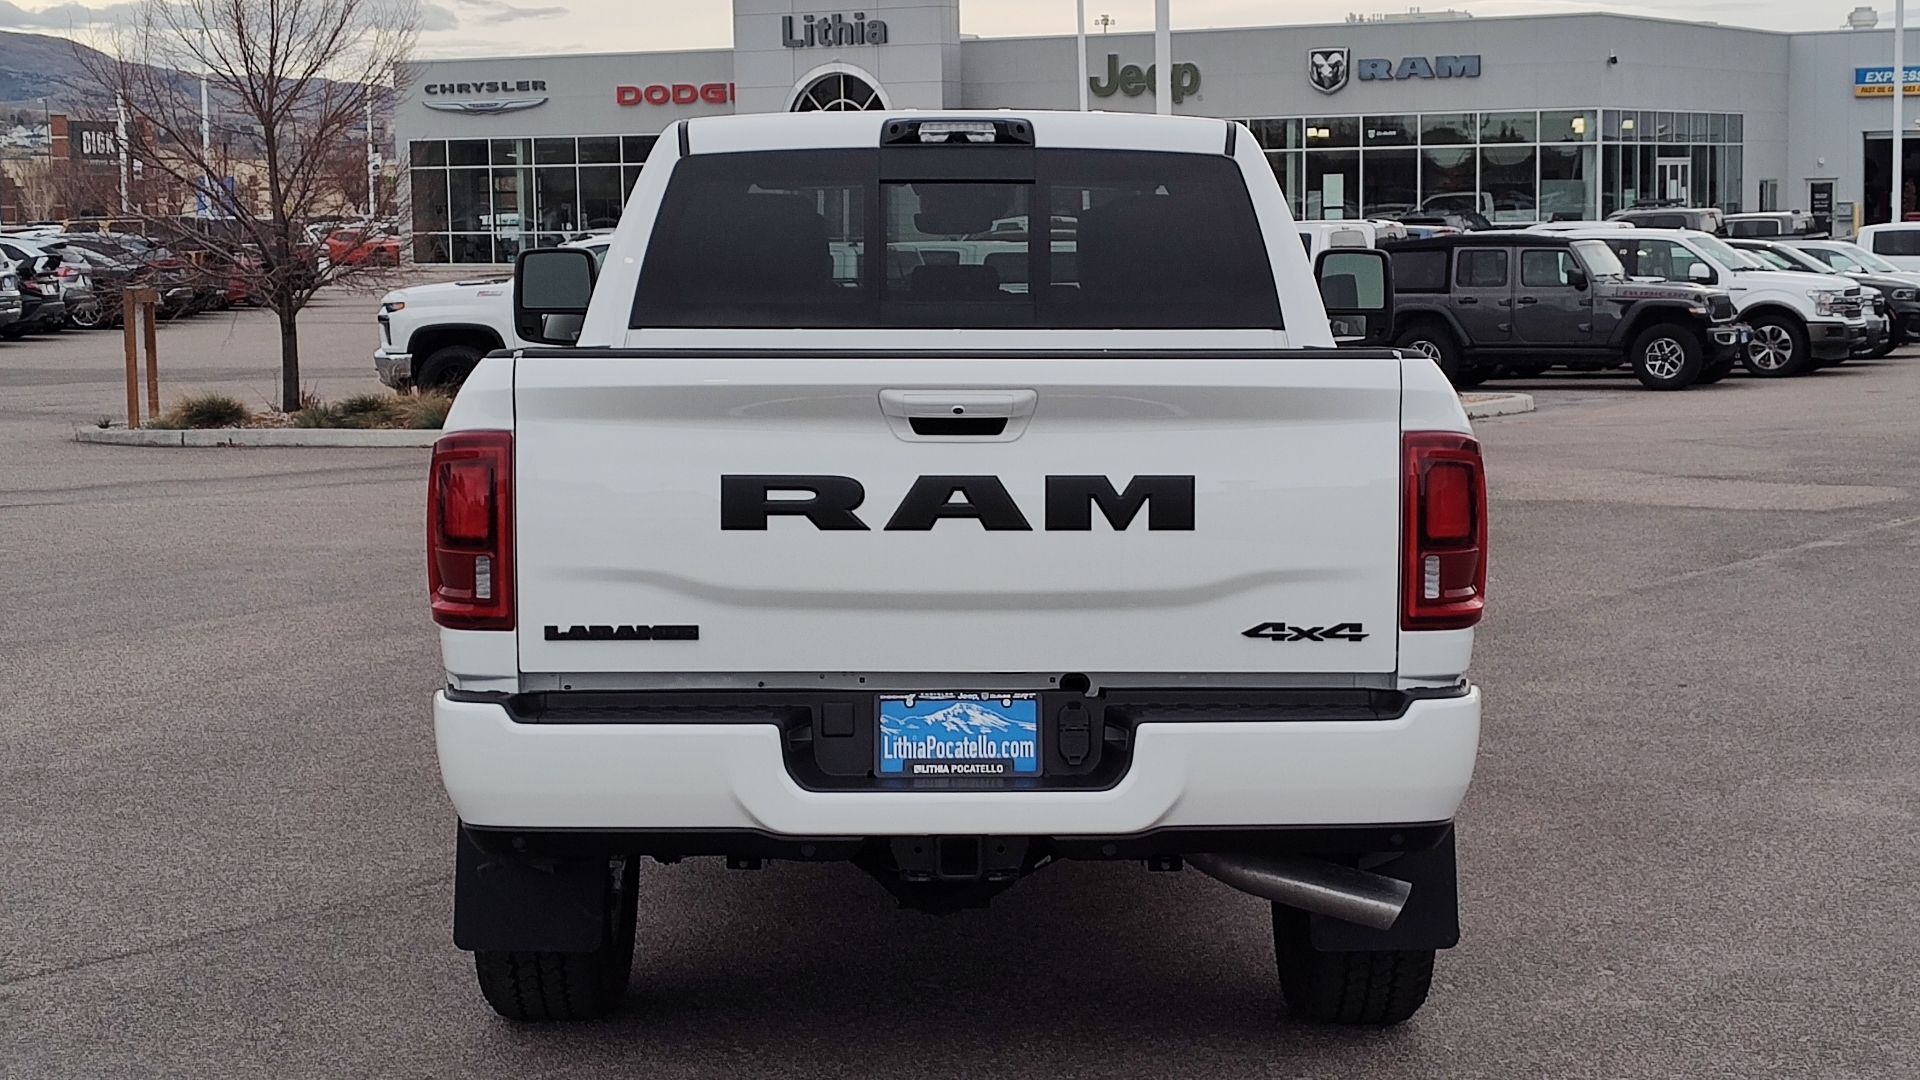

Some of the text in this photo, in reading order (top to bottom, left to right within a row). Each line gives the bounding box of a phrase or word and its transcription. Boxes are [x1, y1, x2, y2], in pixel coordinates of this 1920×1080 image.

[782, 12, 888, 48] Lithia
[1358, 55, 1481, 81] RAM
[1865, 70, 1920, 82] EXPES
[424, 80, 547, 95] CHRYSLER
[616, 82, 735, 106] DODG
[720, 474, 1195, 531] RAM
[544, 625, 700, 641] LARAMIE
[1241, 622, 1370, 641] 4x4
[884, 735, 1034, 759] LithiaPocatello.com
[922, 764, 1004, 774] LITHIA POCATELLO
